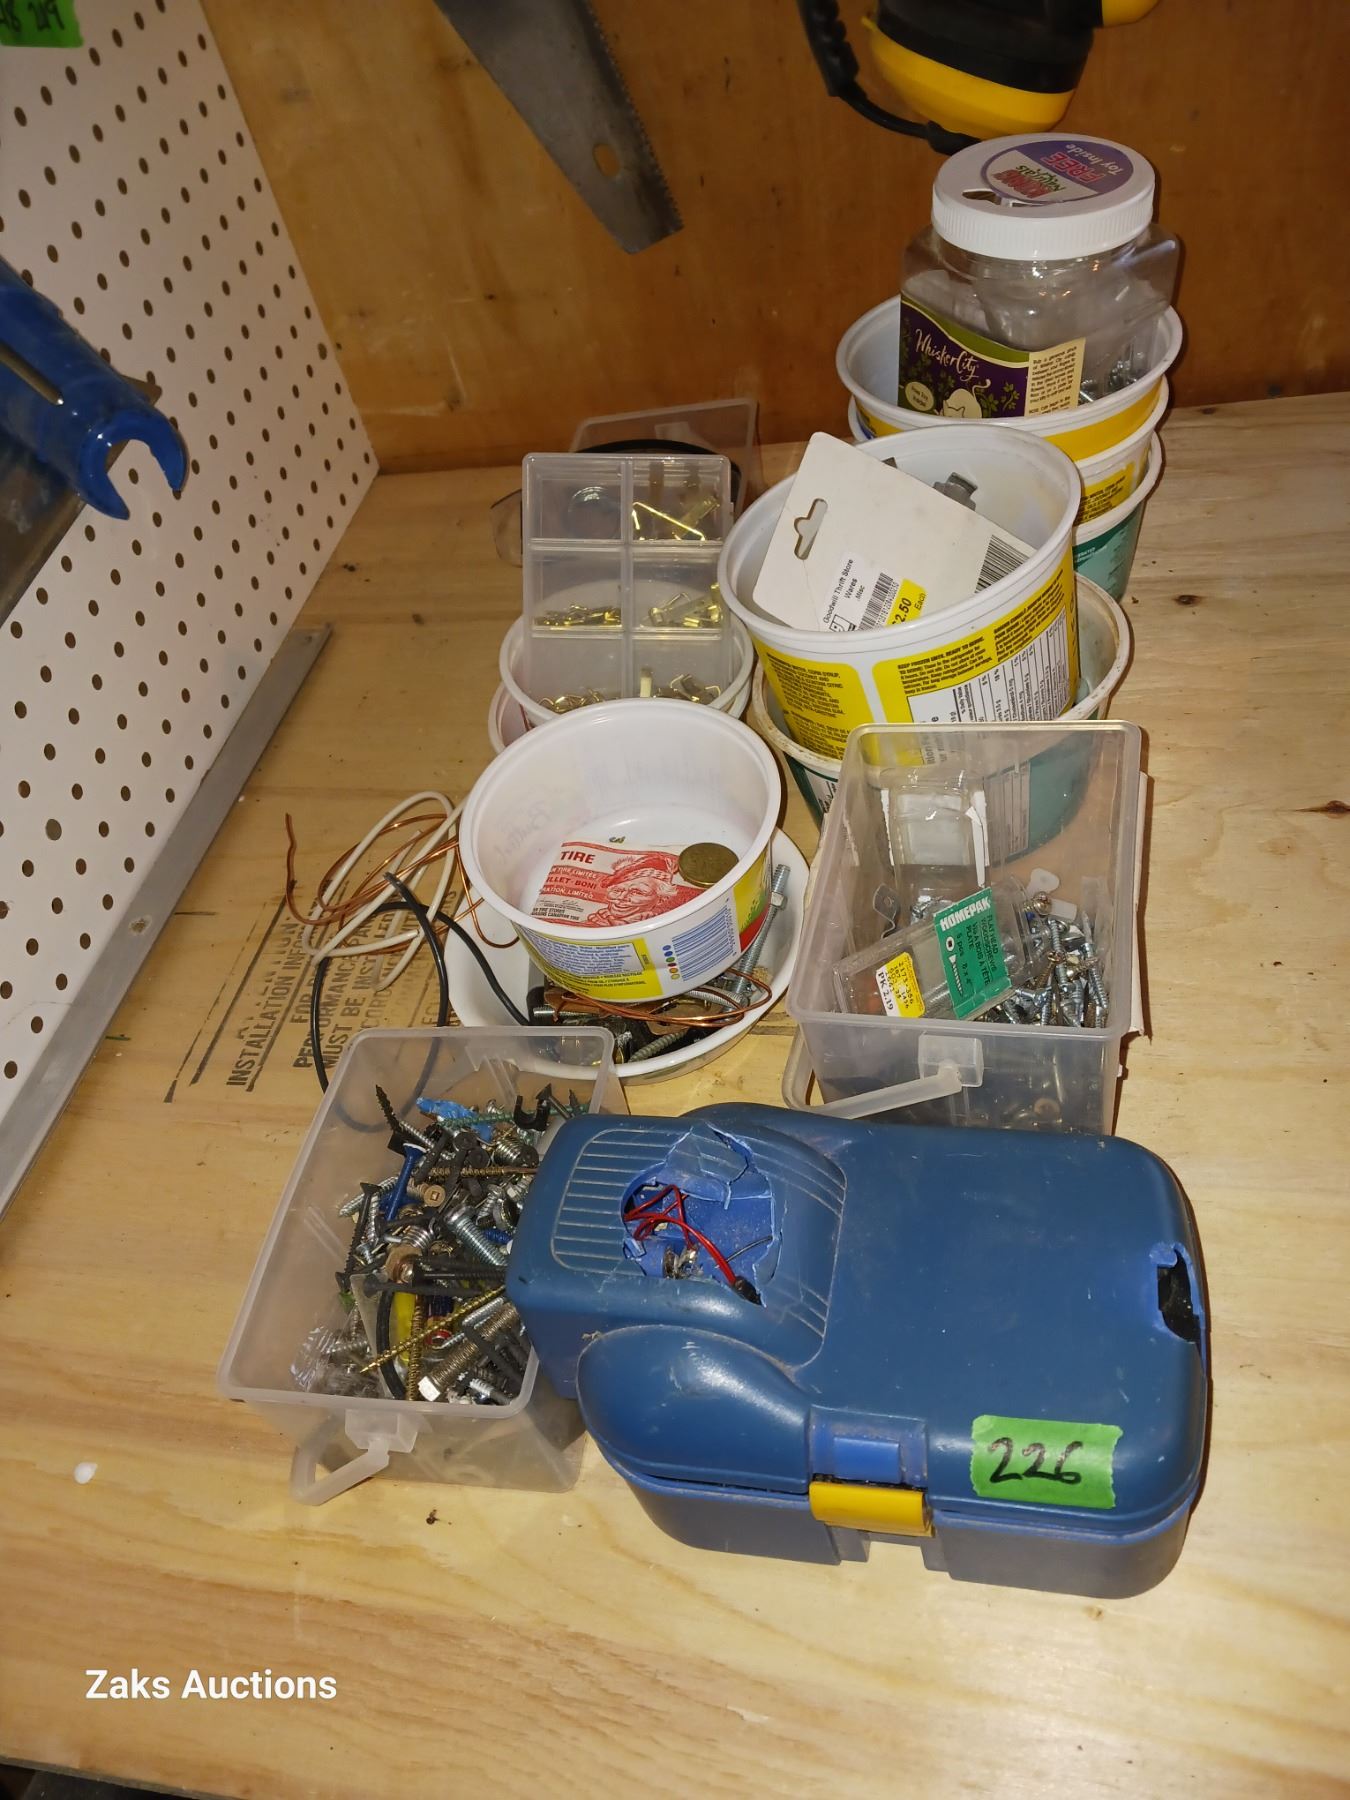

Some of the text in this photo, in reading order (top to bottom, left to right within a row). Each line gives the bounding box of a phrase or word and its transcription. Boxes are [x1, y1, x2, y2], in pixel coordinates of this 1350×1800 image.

[1040, 152, 1103, 183] FREE
[1065, 144, 1123, 175] Toy Inside
[823, 596, 838, 623] Goodwill
[841, 559, 853, 577] Store
[914, 592, 927, 611] Each
[560, 850, 596, 864] TIRE
[546, 876, 570, 884] ILLET
[940, 896, 991, 932] HOMEPAK
[966, 926, 975, 950] PLATE
[987, 914, 999, 954] FLAT HEAD
[878, 972, 894, 1010] PK 2.19
[981, 967, 991, 986] TÊTE
[226, 974, 295, 1086] INSTALLATION
[322, 1023, 353, 1070] MUST
[340, 996, 365, 1017] BE
[988, 1437, 1083, 1485] 226
